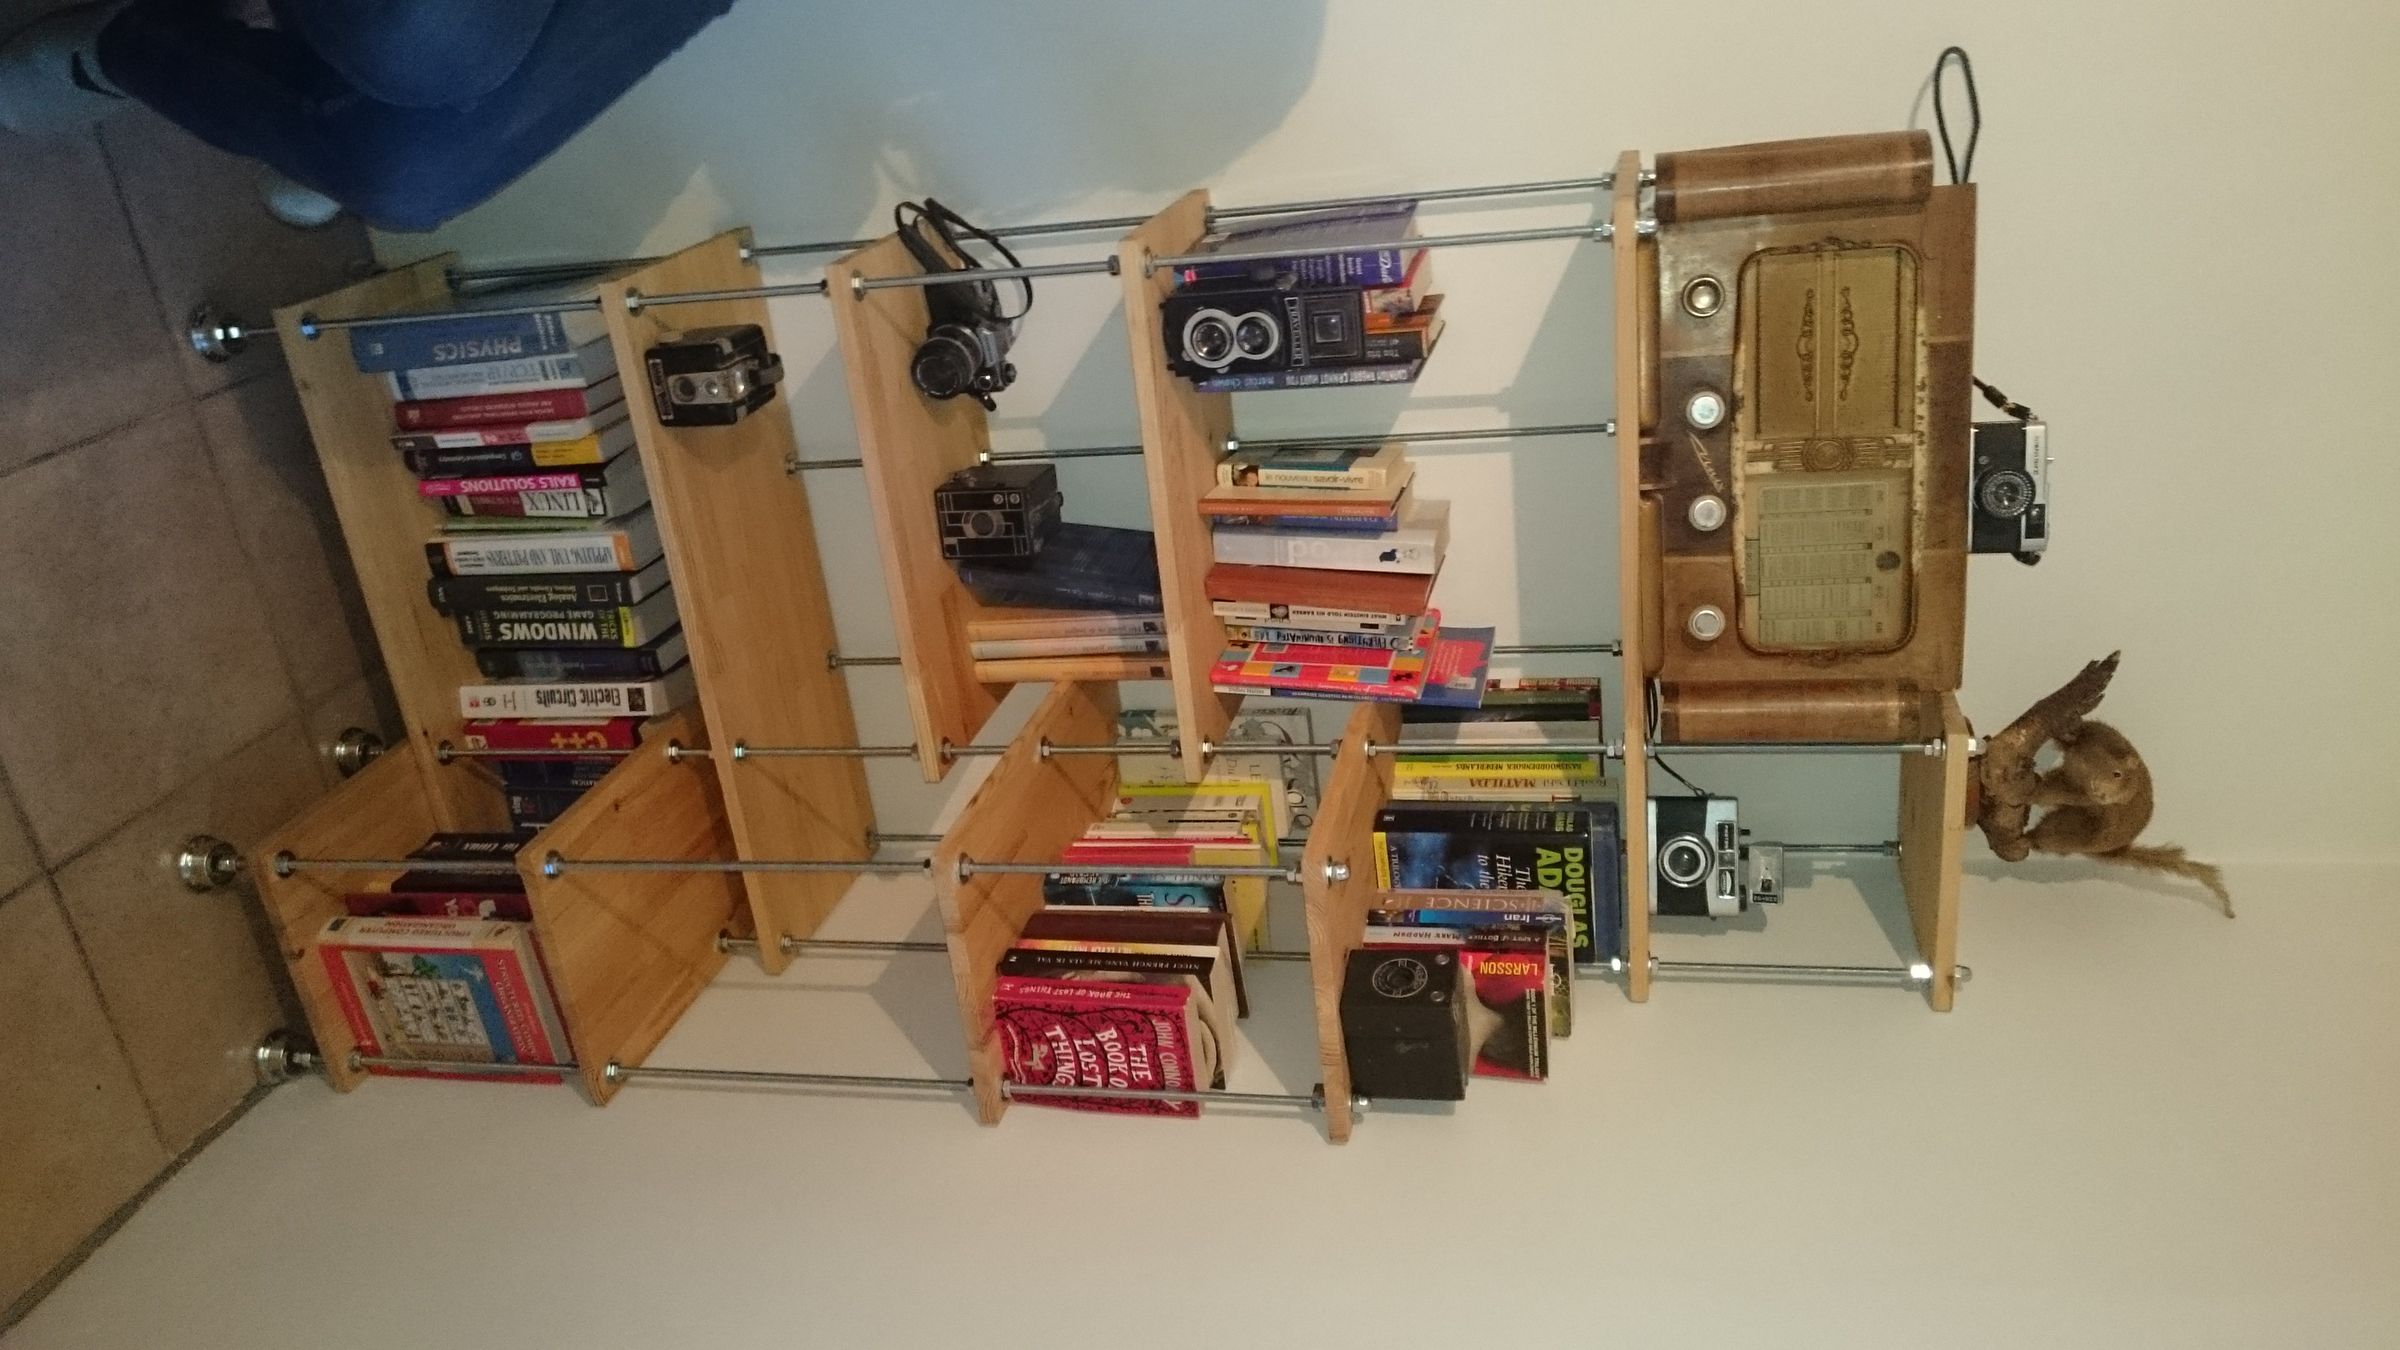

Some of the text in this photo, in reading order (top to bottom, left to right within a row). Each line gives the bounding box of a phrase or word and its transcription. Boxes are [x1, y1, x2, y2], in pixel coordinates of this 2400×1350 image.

[433, 337, 522, 361] PHYSICS
[460, 474, 578, 492] RAILS SOLUTIONS
[1313, 474, 1364, 484] savoir-vivre
[527, 492, 582, 512] LINUX
[499, 622, 598, 641] WINDOWS
[1338, 634, 1387, 650] EVERYTHING
[536, 688, 620, 708] Electric Circuits
[1456, 762, 1504, 771] NEDERLANDS
[1468, 778, 1536, 788] MATILDA
[1477, 854, 1492, 889] to the
[1515, 867, 1531, 890] The
[1424, 897, 1519, 911] SCIENCE
[1563, 847, 1588, 949] DOUGLAS
[1503, 913, 1530, 923] Iran
[1132, 961, 1169, 969] FRENCH
[1480, 961, 1539, 976] LARSSON
[1019, 983, 1132, 999] THE BOOK OF LOST THINGS
[1045, 1025, 1076, 1087] THING
[1095, 1027, 1128, 1076] BOOK
[1073, 1039, 1102, 1088] LOST
[1129, 1043, 1153, 1081] THE
[1152, 1019, 1182, 1111] JOHN CONNOY
